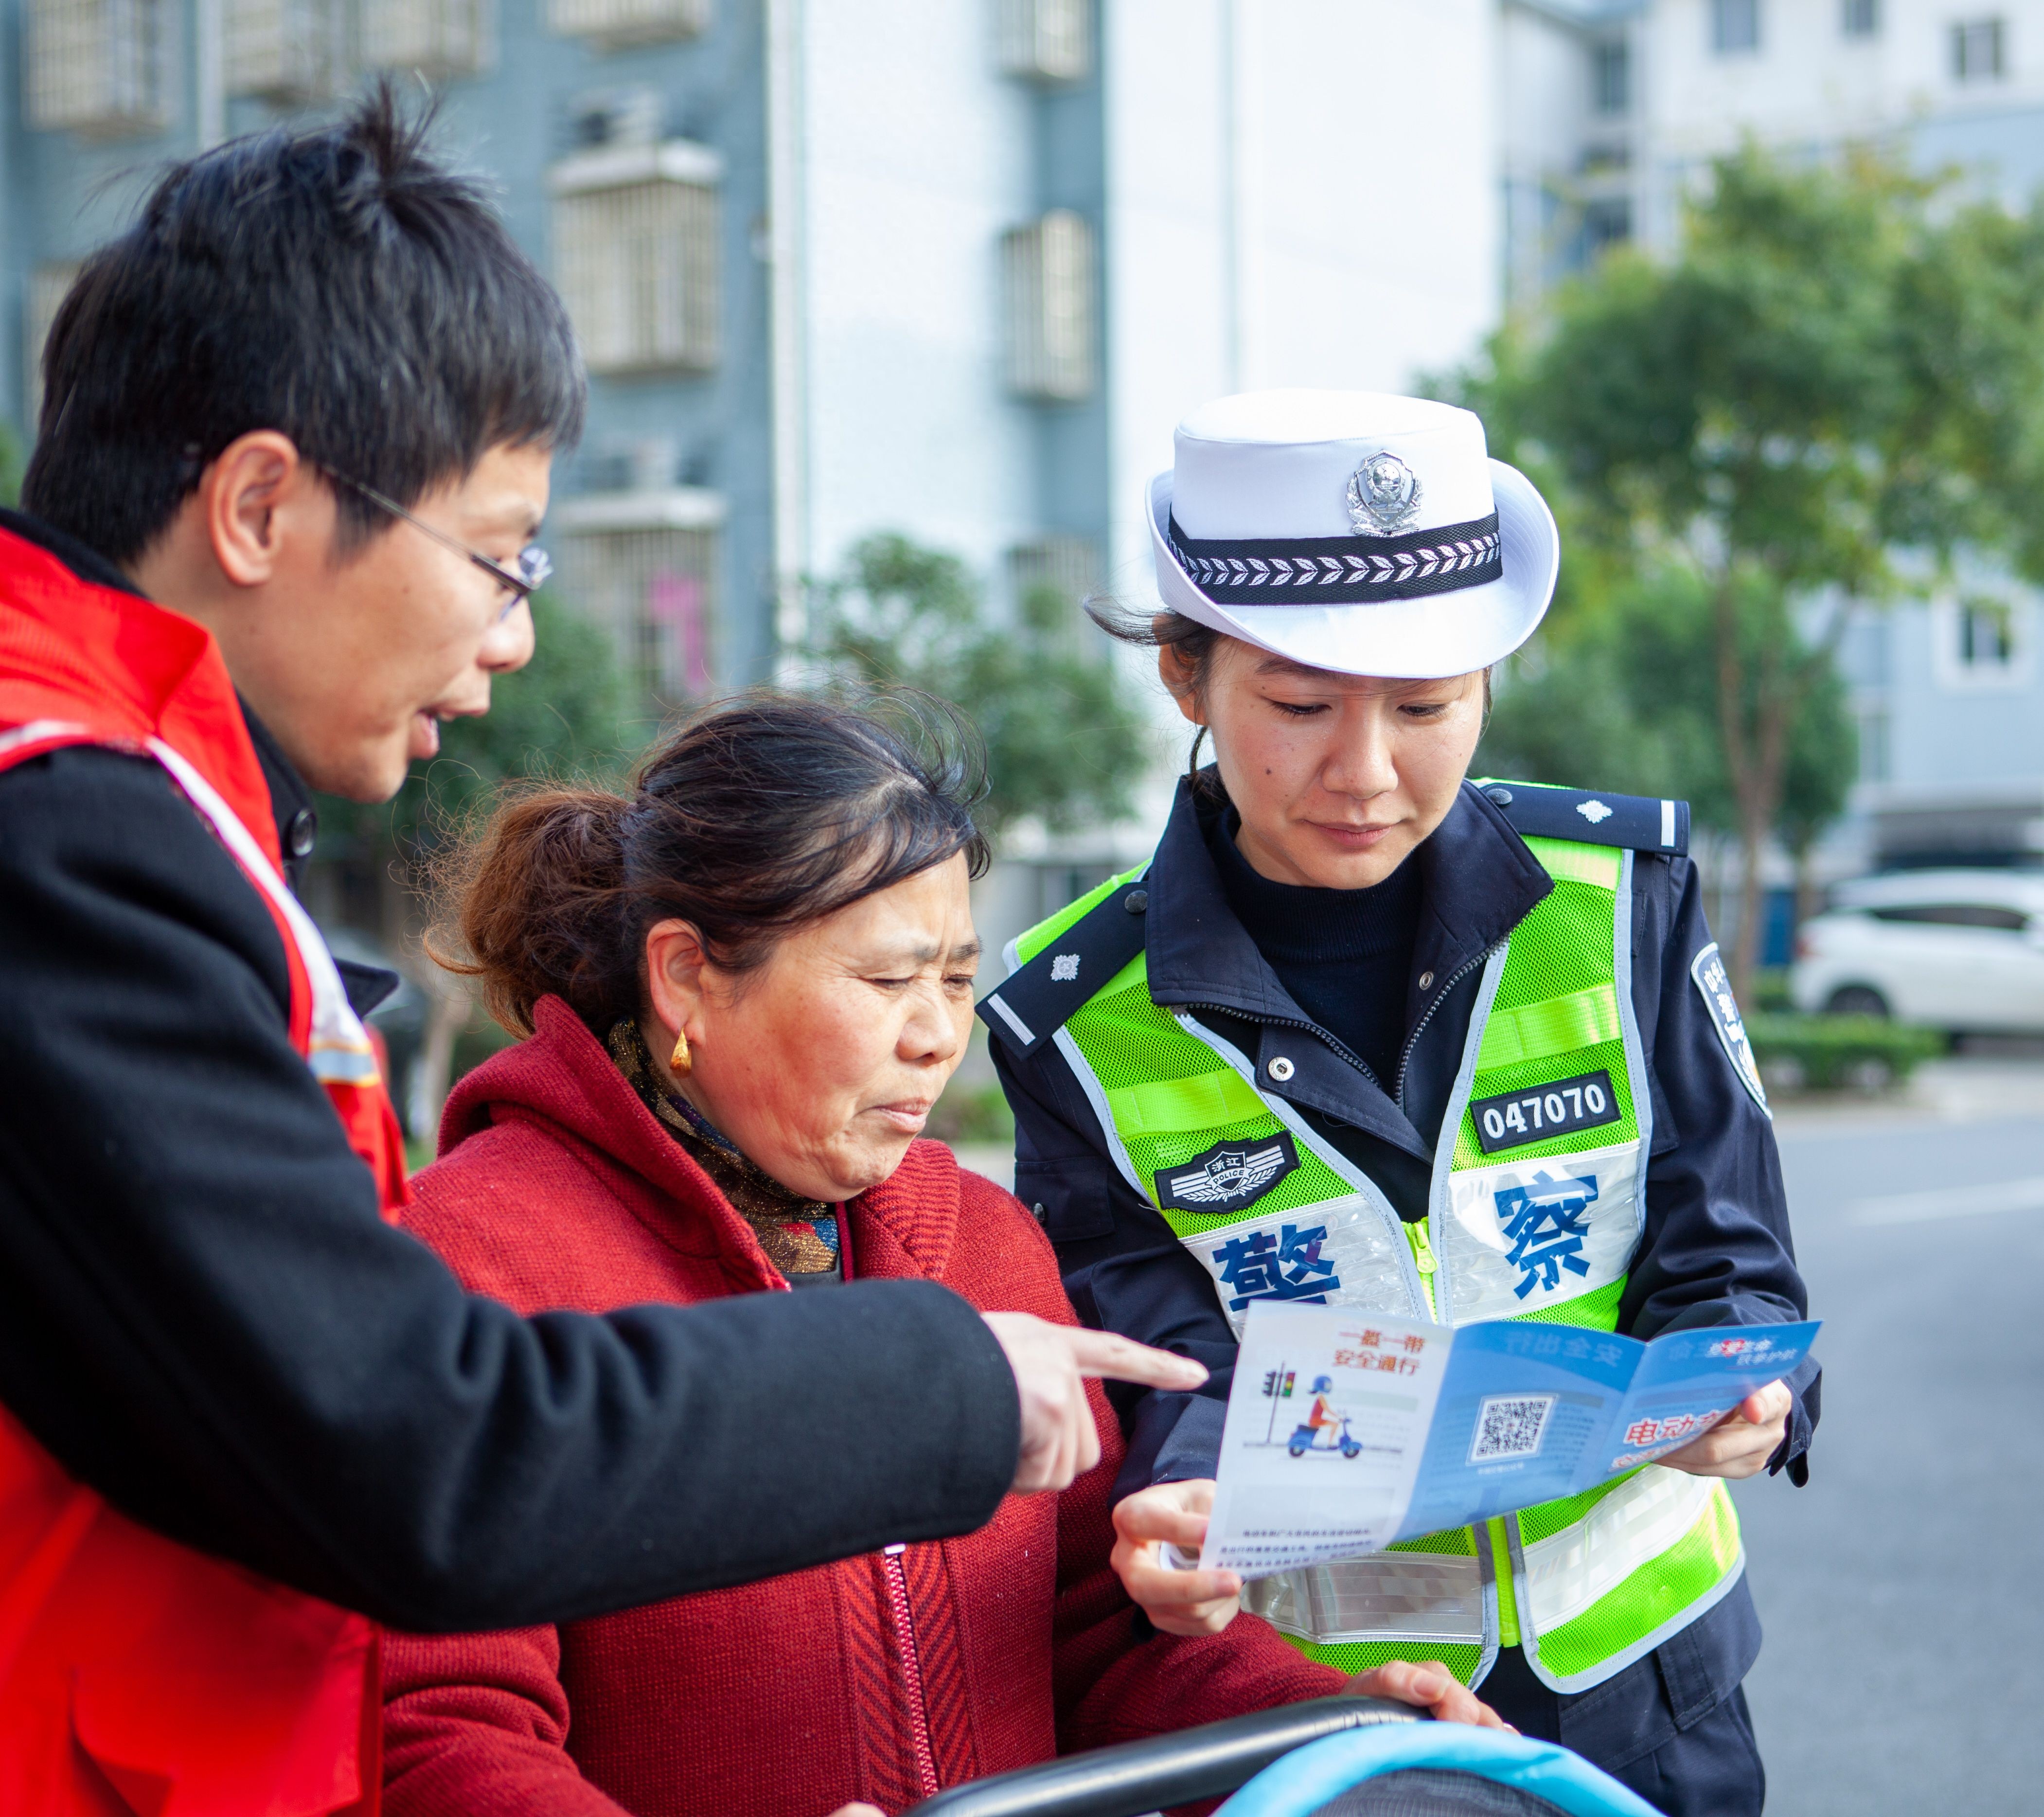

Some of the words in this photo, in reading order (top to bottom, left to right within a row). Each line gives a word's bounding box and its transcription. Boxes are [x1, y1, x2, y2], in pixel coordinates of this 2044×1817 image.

[1482, 1083, 1607, 1140] 047070
[1213, 1169, 1245, 1185] POLICE
[1212, 1224, 1341, 1312] 警
[1493, 1169, 1598, 1300] 察
[1338, 1328, 1426, 1354] 一盔一带
[1332, 1348, 1420, 1376] 安全通行
